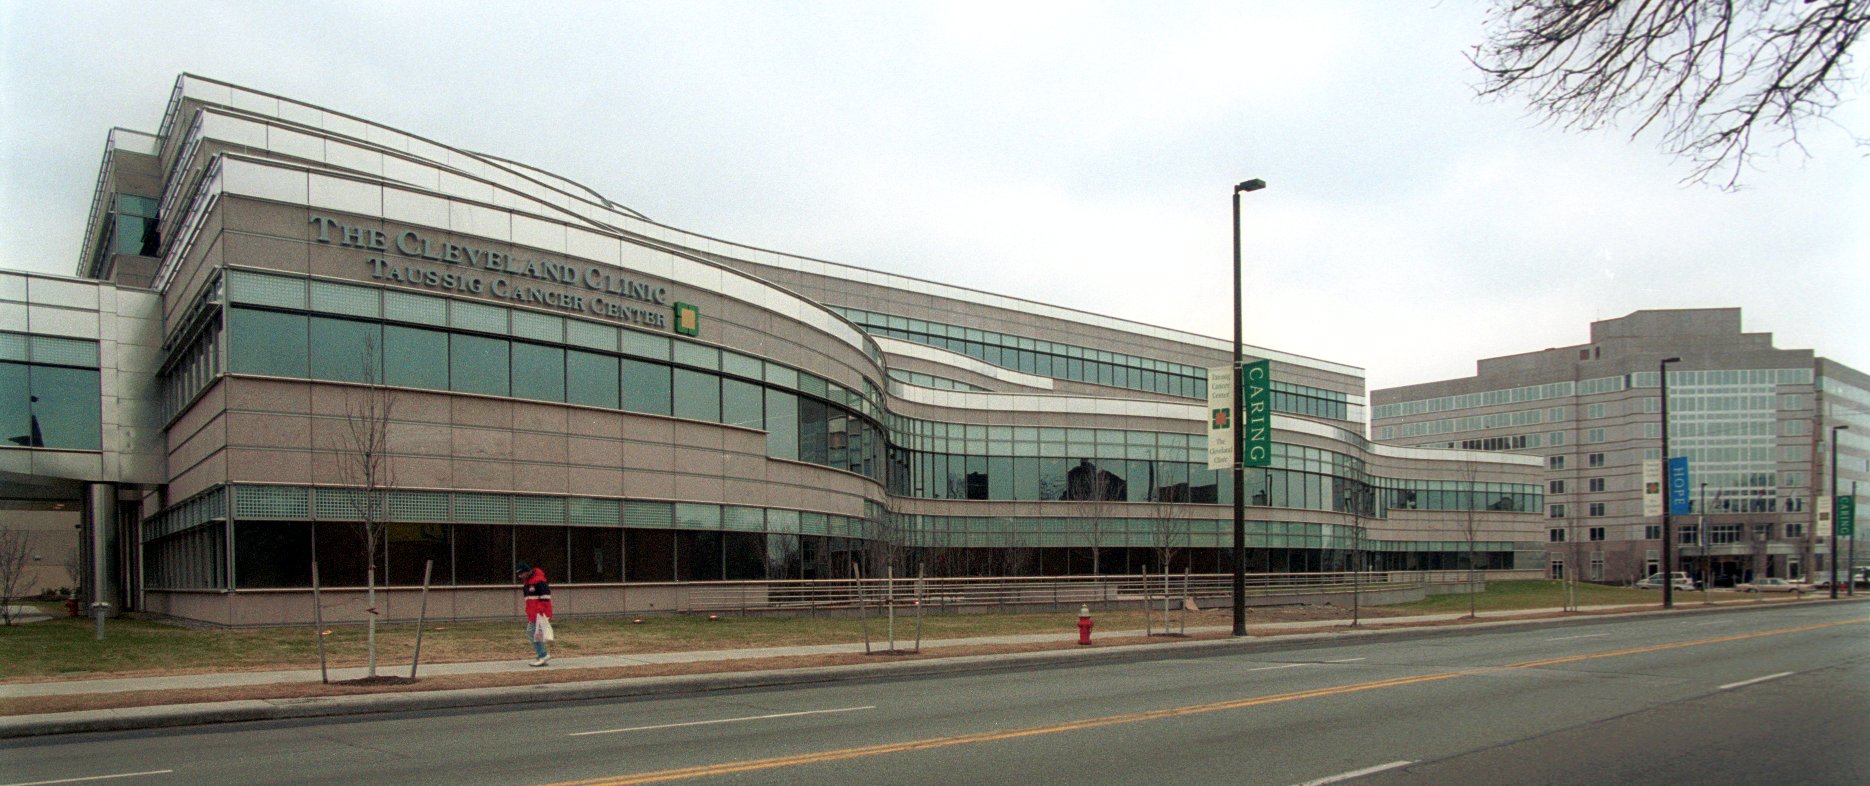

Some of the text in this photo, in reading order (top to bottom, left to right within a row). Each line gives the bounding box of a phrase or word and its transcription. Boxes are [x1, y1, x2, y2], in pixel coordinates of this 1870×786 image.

[309, 215, 667, 305] THE CLEVELAND CLINIC
[367, 256, 666, 329] TAUSSIG CANCER CENTER
[1249, 367, 1265, 462] CARING
[1673, 467, 1686, 505] HOPE
[1839, 497, 1850, 535] CARING
